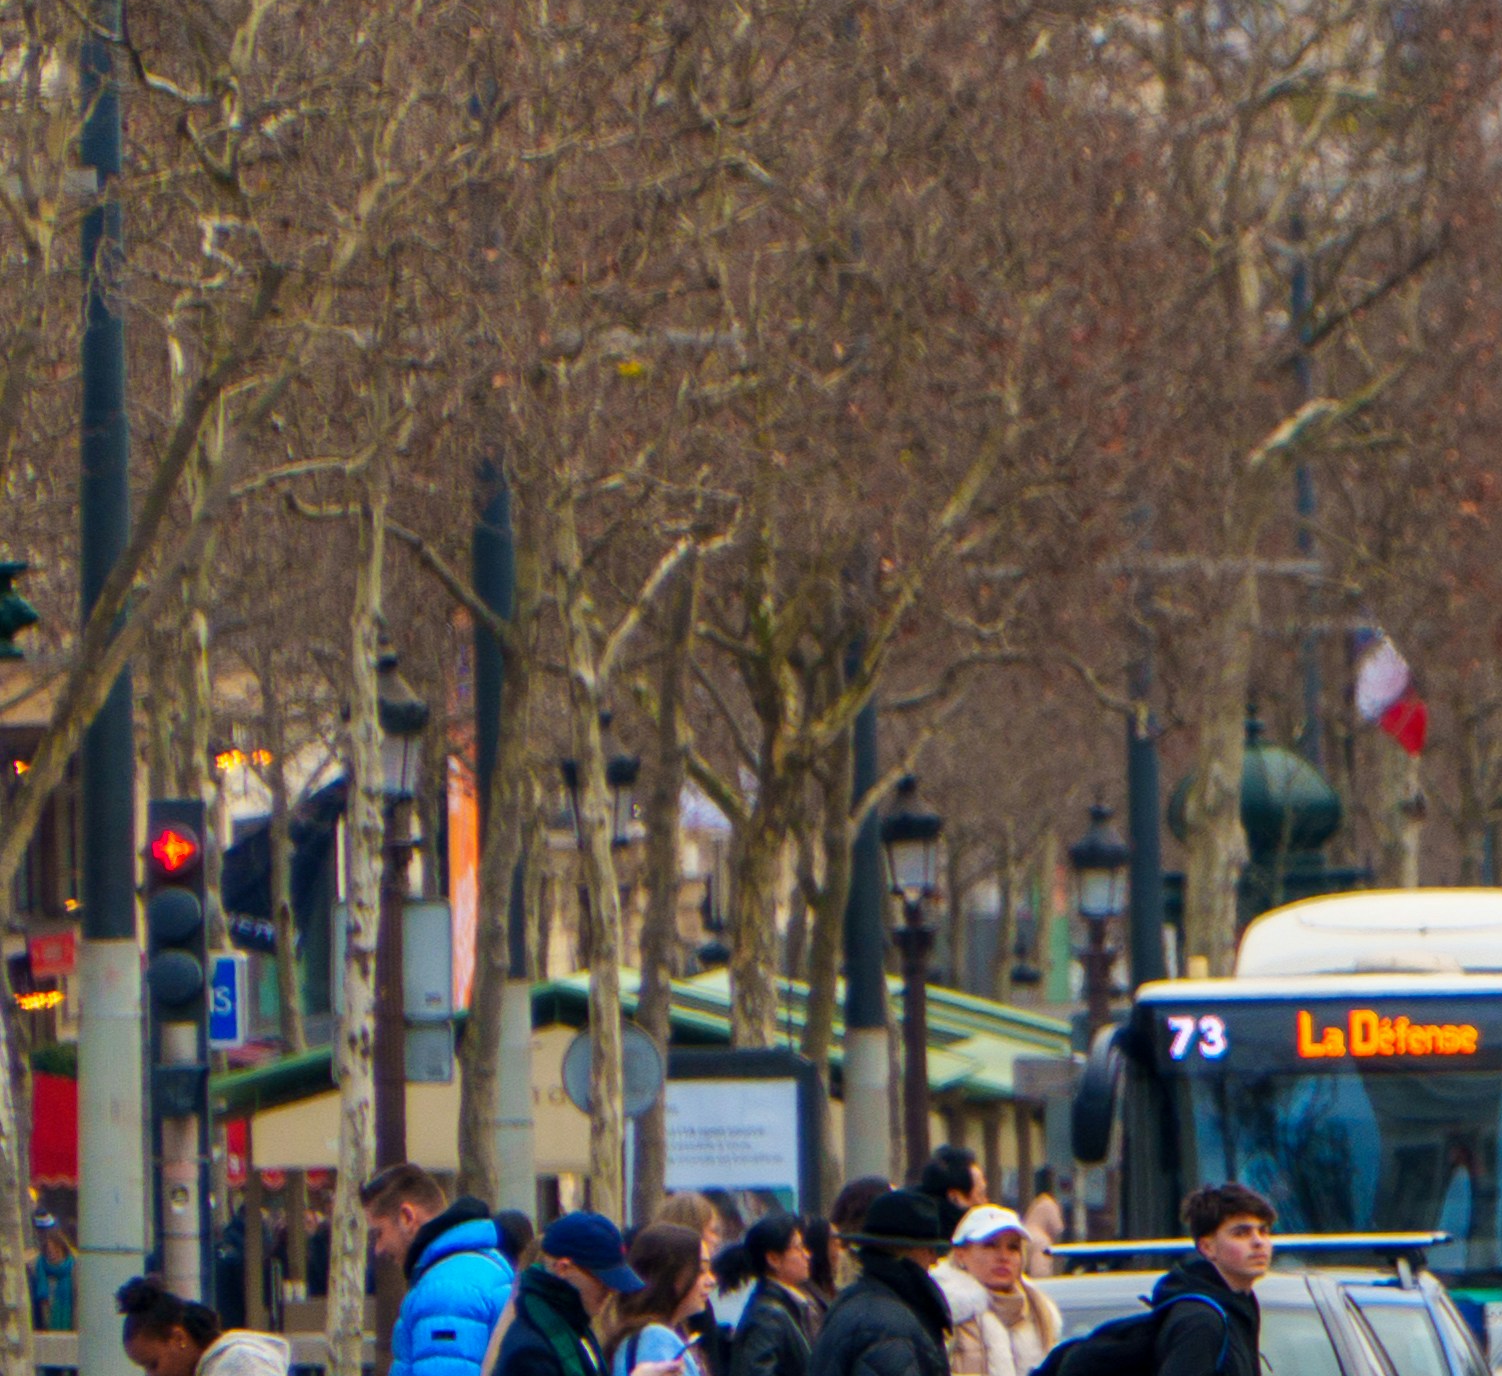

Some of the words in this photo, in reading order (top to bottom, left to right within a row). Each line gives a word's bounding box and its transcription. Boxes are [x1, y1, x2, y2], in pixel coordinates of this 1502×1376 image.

[1168, 1015, 1229, 1060] 73
[1297, 1010, 1346, 1057] La
[1348, 1008, 1479, 1056] Défense
